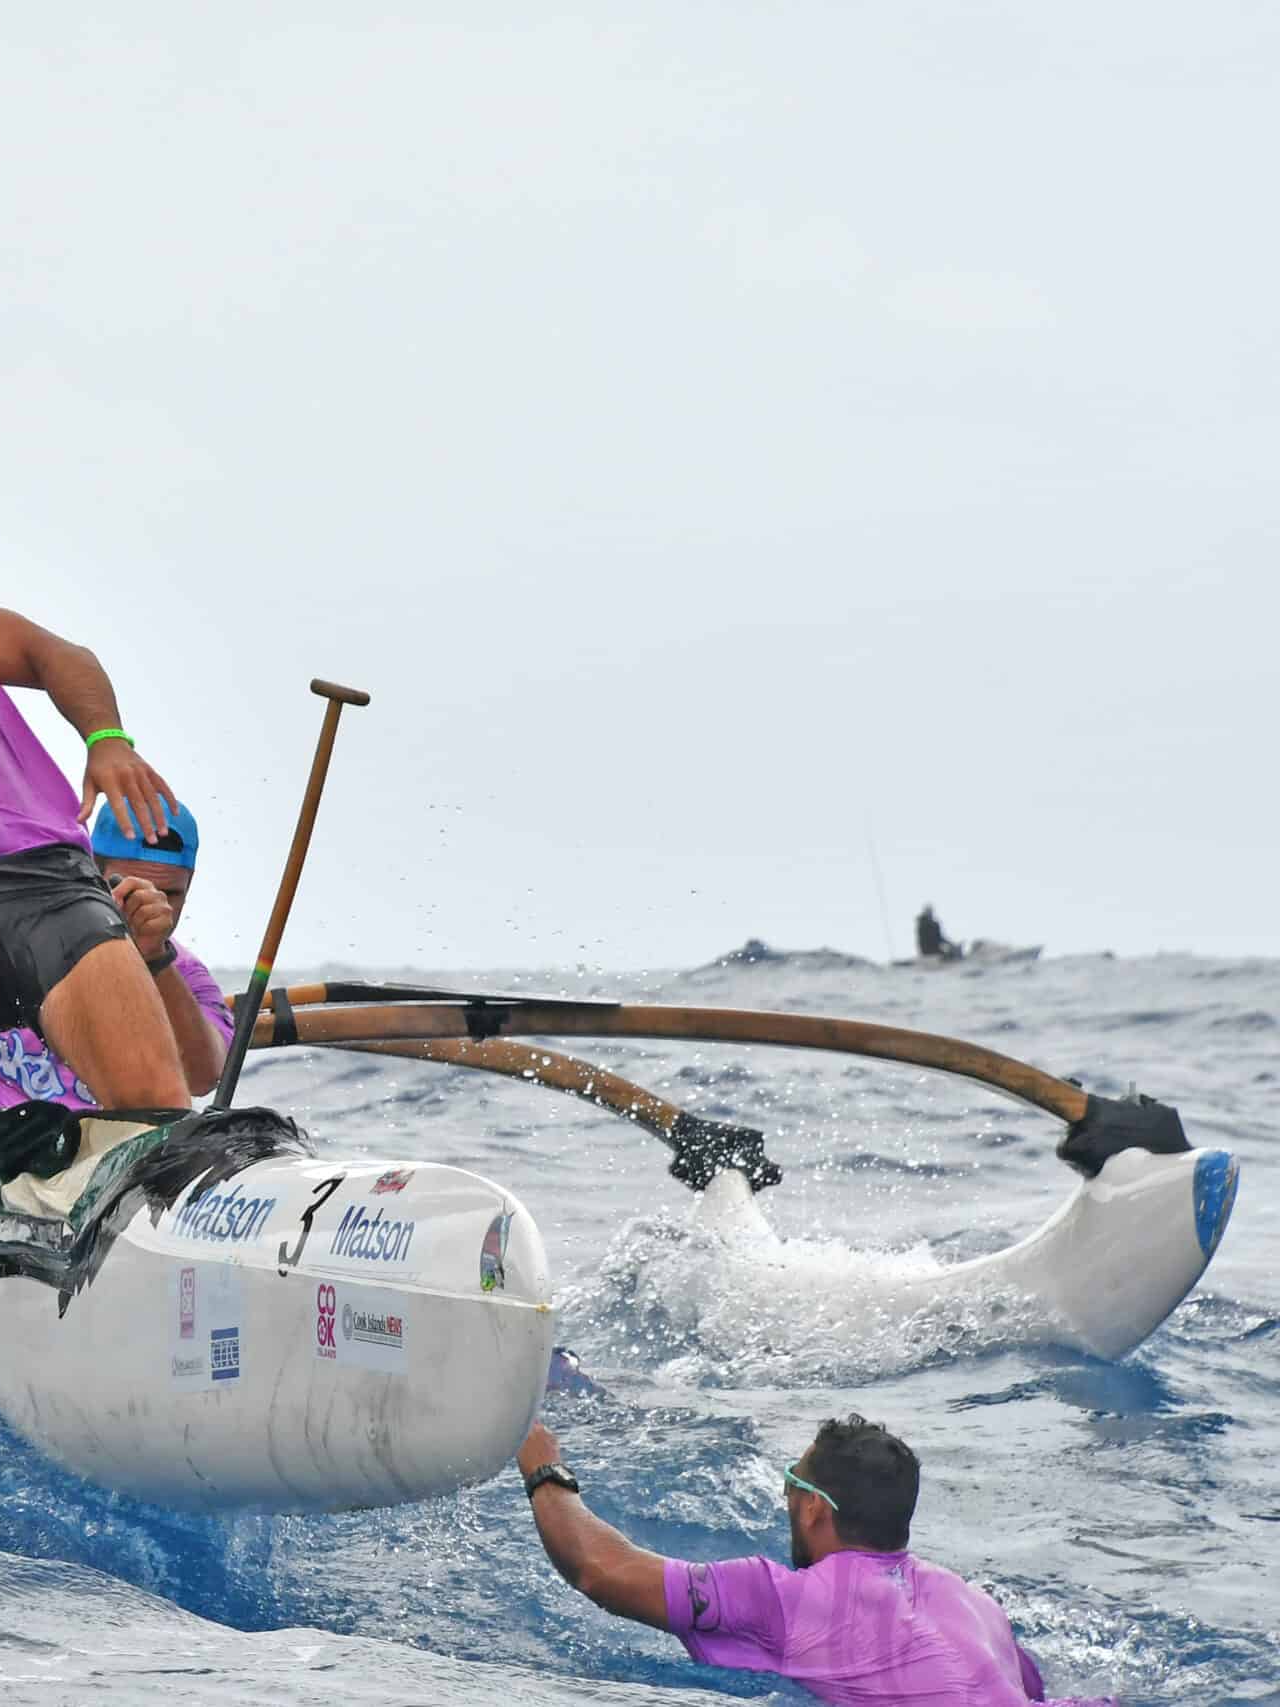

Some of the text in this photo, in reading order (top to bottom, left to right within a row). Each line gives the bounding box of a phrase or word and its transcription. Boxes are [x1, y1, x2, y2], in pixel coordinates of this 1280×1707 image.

[171, 1184, 279, 1244] Matson
[278, 1171, 348, 1278] 3
[329, 1204, 416, 1263] Matson
